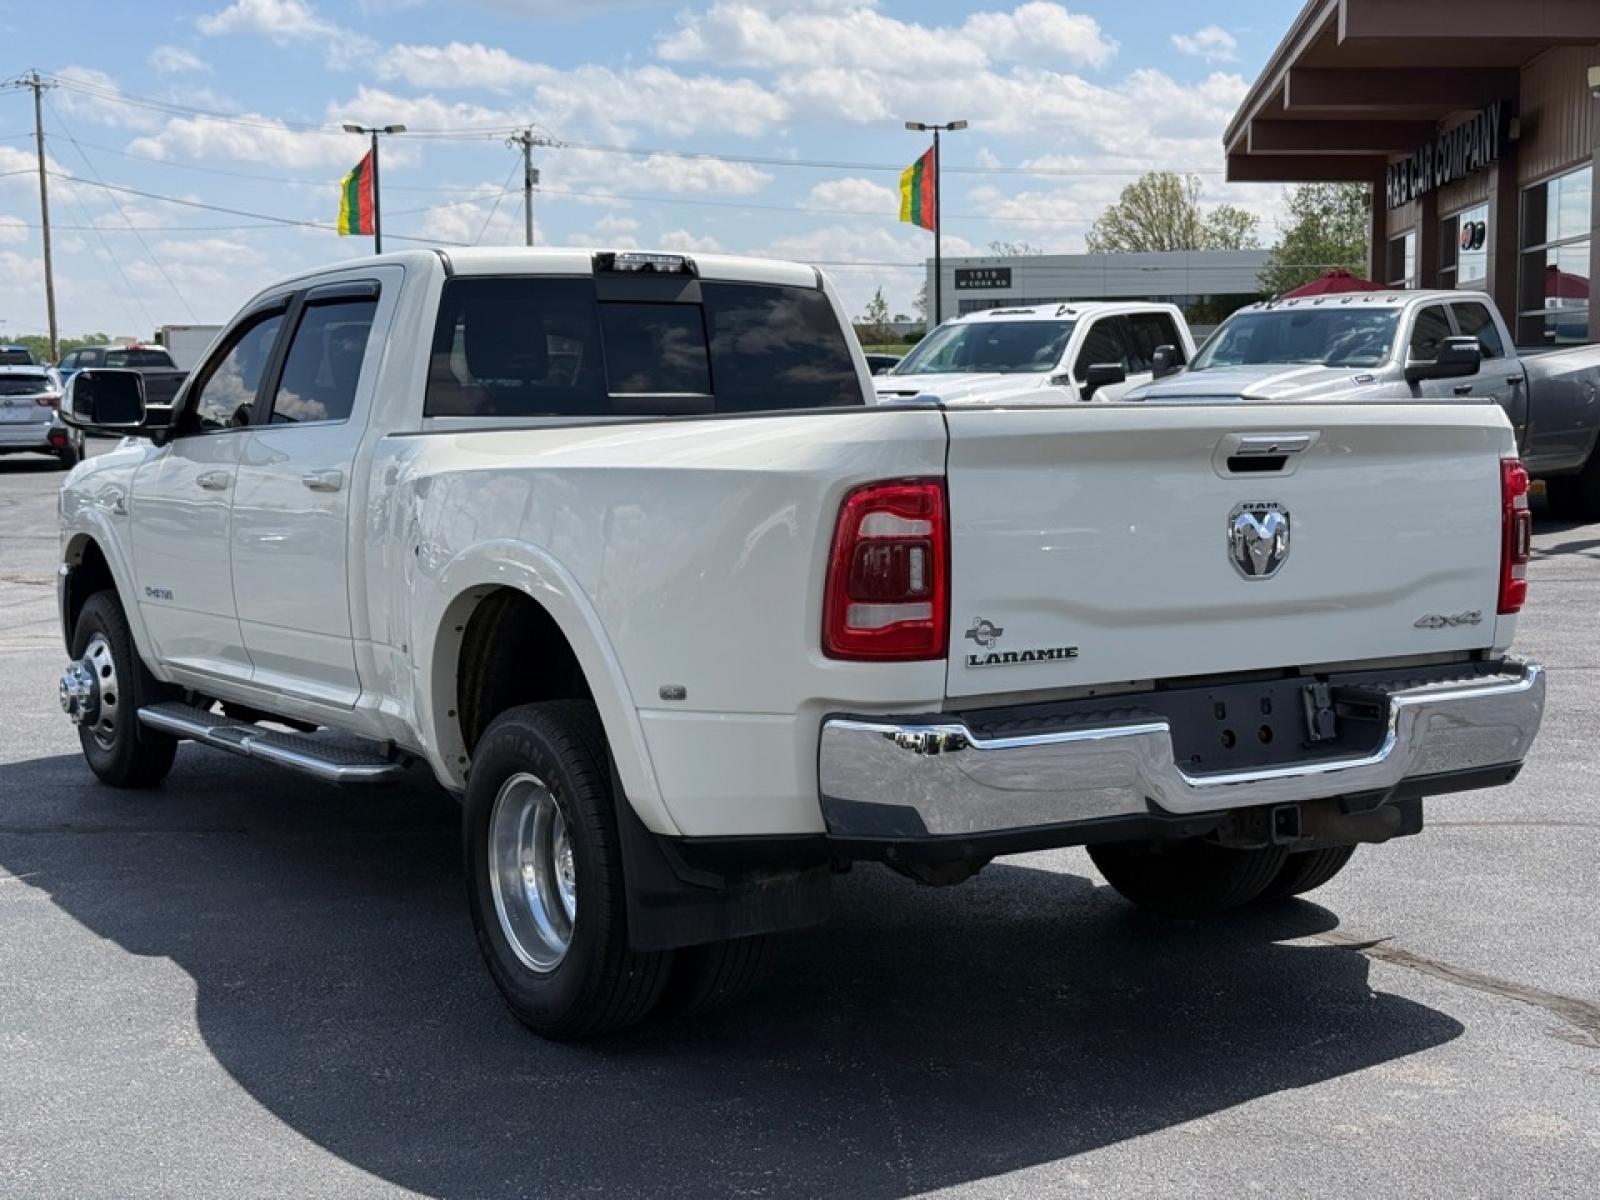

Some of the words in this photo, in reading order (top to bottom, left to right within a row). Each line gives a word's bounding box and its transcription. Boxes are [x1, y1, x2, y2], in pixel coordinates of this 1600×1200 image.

[1410, 142, 1433, 199] CAR
[1434, 99, 1501, 187] COMPANY
[1242, 501, 1279, 511] RAM
[964, 647, 1080, 670] LARAMIE
